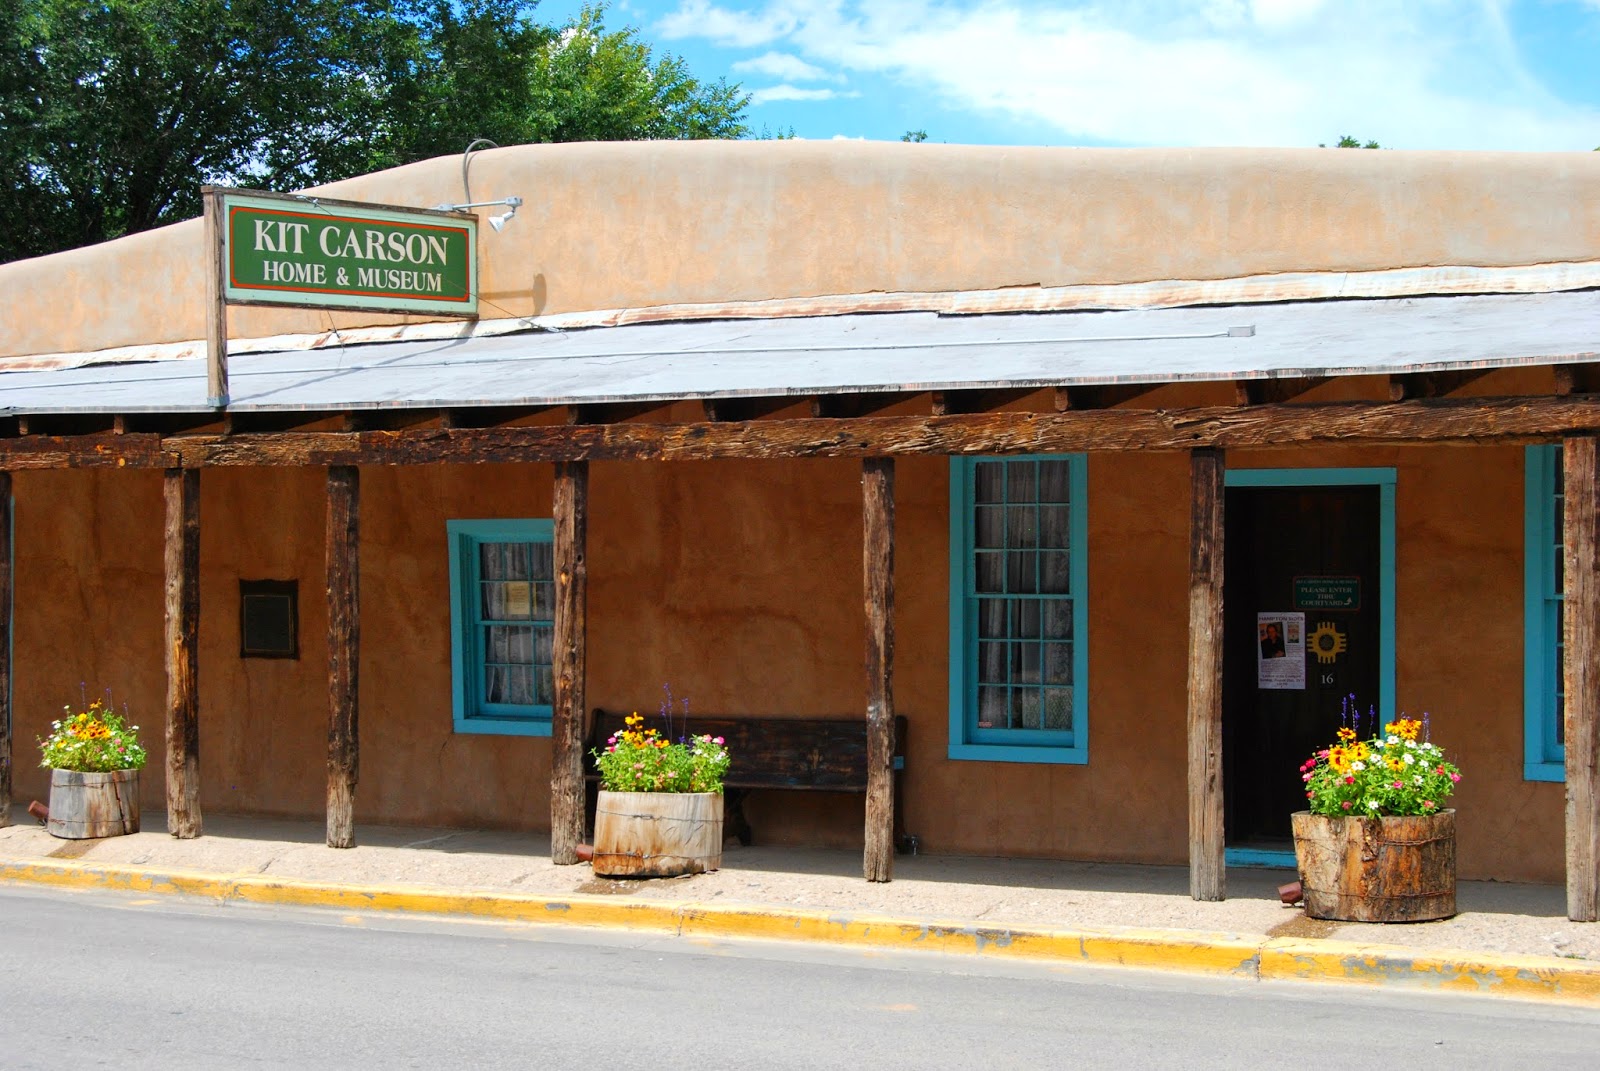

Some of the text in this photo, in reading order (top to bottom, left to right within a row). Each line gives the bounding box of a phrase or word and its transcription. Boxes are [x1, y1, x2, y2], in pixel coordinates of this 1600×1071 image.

[254, 219, 449, 266] KIT CARSON
[263, 260, 442, 292] HOME & MUSEUM
[1321, 673, 1334, 684] 16
